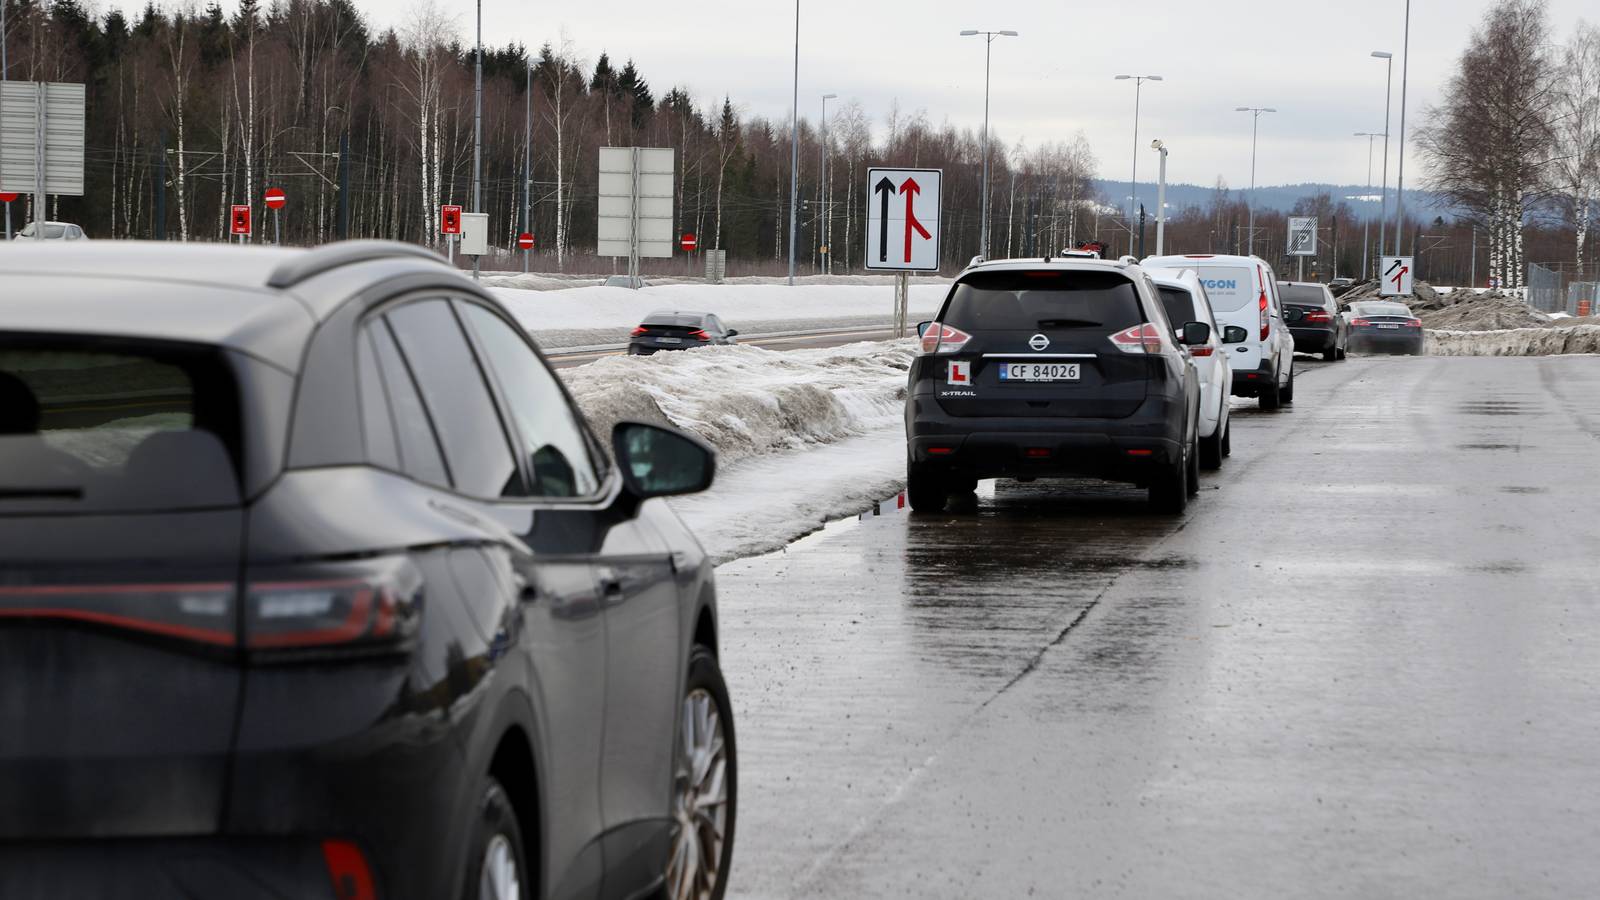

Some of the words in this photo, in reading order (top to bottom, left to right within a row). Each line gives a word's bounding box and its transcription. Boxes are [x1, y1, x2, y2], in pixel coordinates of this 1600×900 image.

[952, 365, 966, 381] L
[1011, 365, 1027, 378] CF
[1033, 365, 1076, 378] 84026
